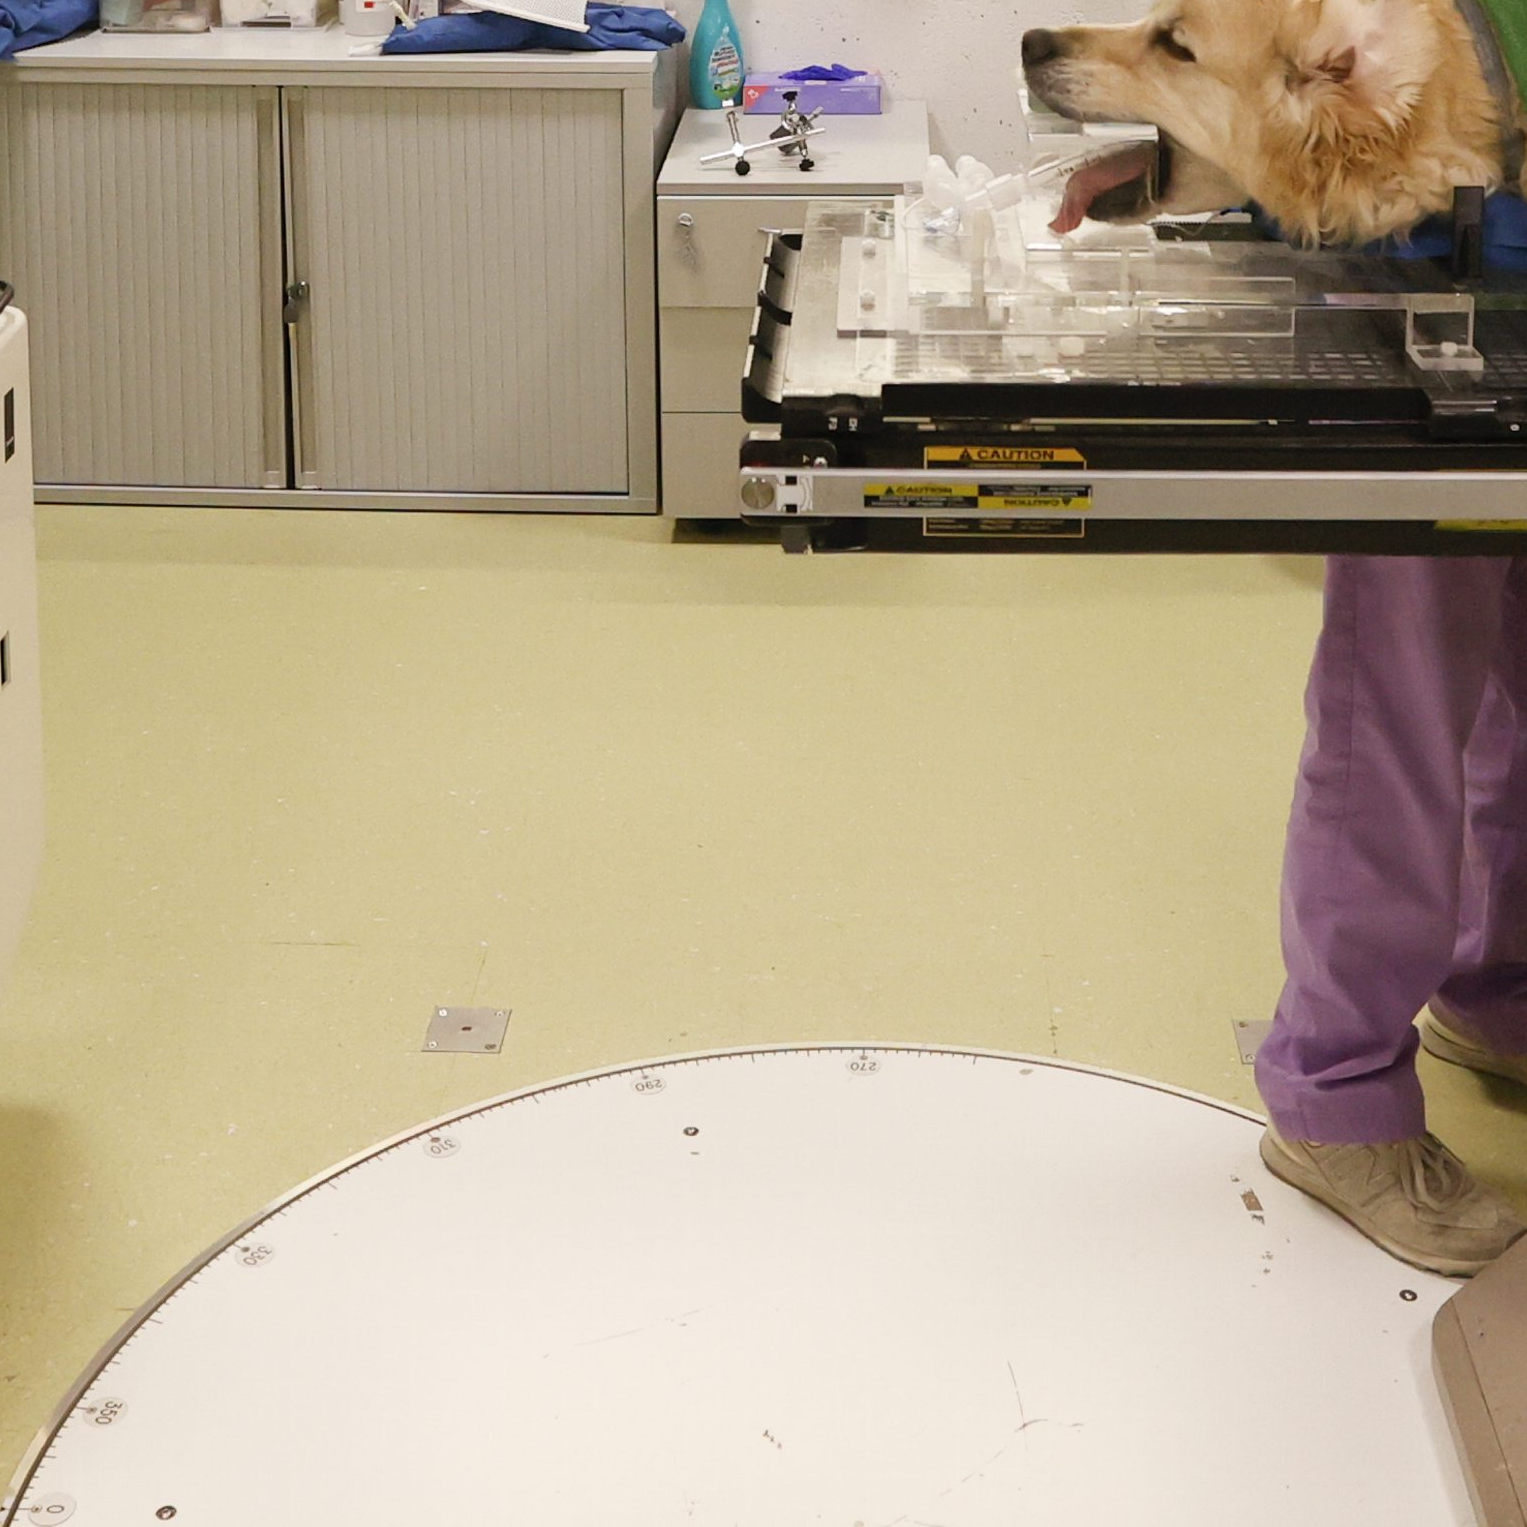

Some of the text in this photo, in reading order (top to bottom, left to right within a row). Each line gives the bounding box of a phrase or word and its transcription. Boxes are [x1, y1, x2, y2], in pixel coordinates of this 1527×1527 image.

[977, 449, 1055, 461] CAUTION
[896, 486, 953, 495] CAUTION
[1003, 498, 1060, 506] CAUTION
[851, 1060, 876, 1072] 270
[635, 1078, 662, 1092] 290
[430, 1138, 456, 1155] 310
[243, 1245, 273, 1266] 330
[95, 1401, 123, 1425] 350
[46, 1504, 65, 1514] 0
